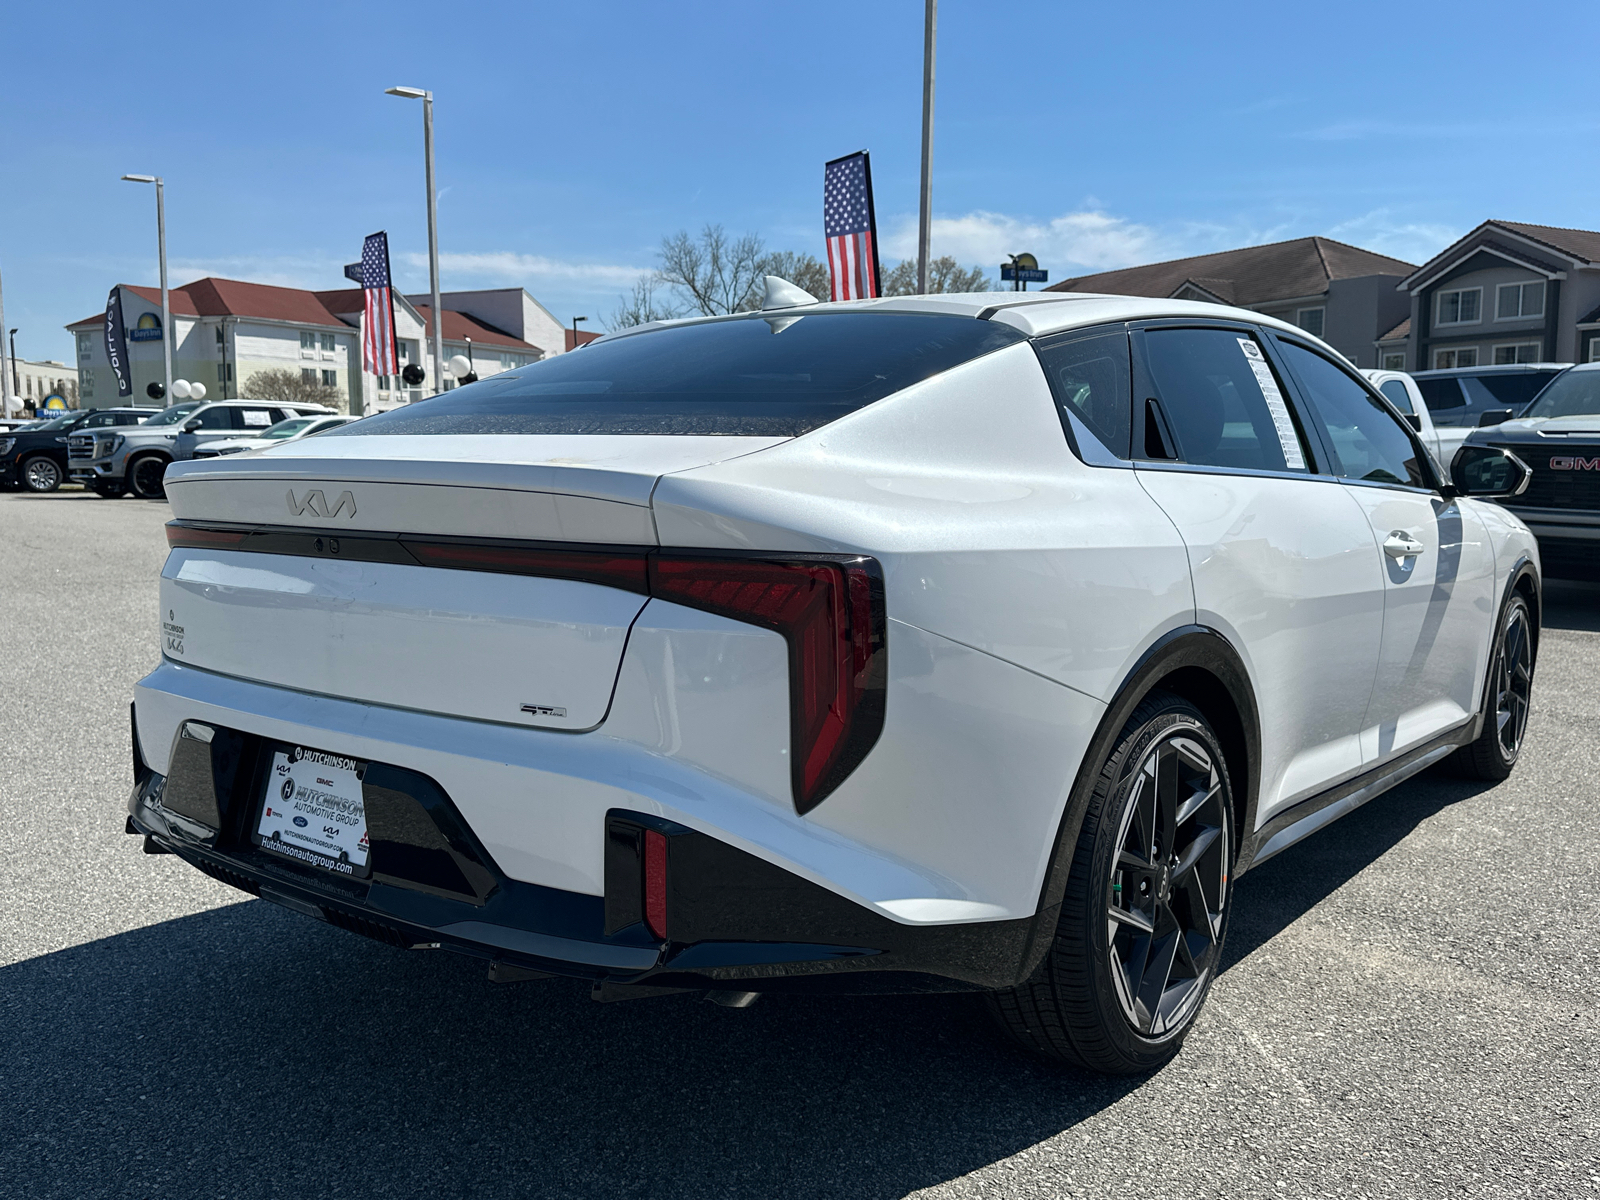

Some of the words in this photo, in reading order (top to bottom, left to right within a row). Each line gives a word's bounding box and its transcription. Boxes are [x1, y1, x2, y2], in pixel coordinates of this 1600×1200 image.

[1011, 270, 1029, 278] Dys
[1030, 270, 1043, 278] Inn
[134, 330, 150, 338] Days
[286, 488, 357, 519] KIA
[303, 750, 357, 771] HUTCHINSON
[316, 777, 334, 787] GMC
[295, 786, 364, 817] HUTCHINSON
[294, 802, 335, 821] AUTOMOTIVE
[336, 813, 359, 827] GROUP
[261, 836, 353, 874] Hutchinsonautogroup.com
